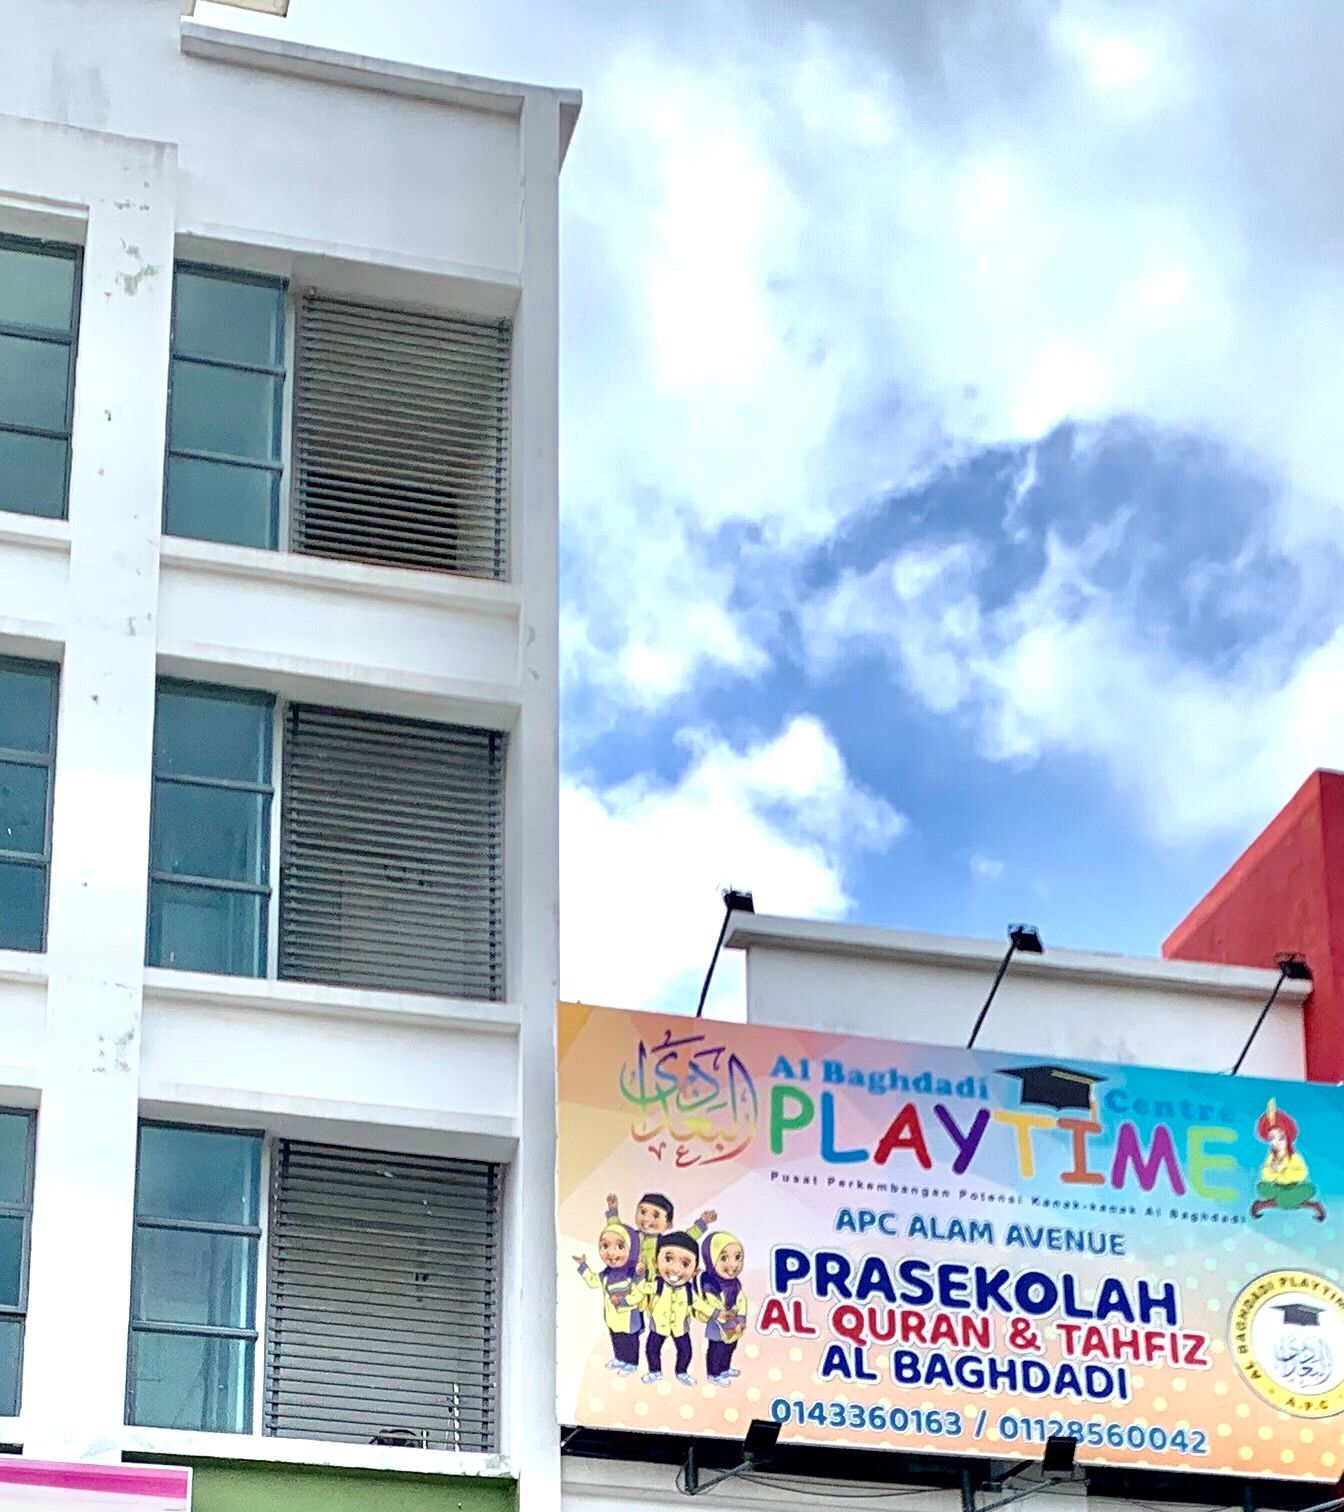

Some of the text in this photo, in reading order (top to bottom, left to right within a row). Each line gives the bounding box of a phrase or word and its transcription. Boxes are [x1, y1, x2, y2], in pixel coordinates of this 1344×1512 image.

[769, 1055, 1234, 1122] Al Baghdadi Centre
[769, 1085, 1238, 1200] PLAYTIME
[835, 1209, 1125, 1256] APC ALAM AVENUE
[773, 1247, 1178, 1327] PRASEKOLAH
[759, 1302, 1210, 1367] AL QURAN & TAHFIZ
[820, 1346, 1127, 1400] AL BAGHDADI
[771, 1399, 1208, 1454] 0143360163 / 01128560042
